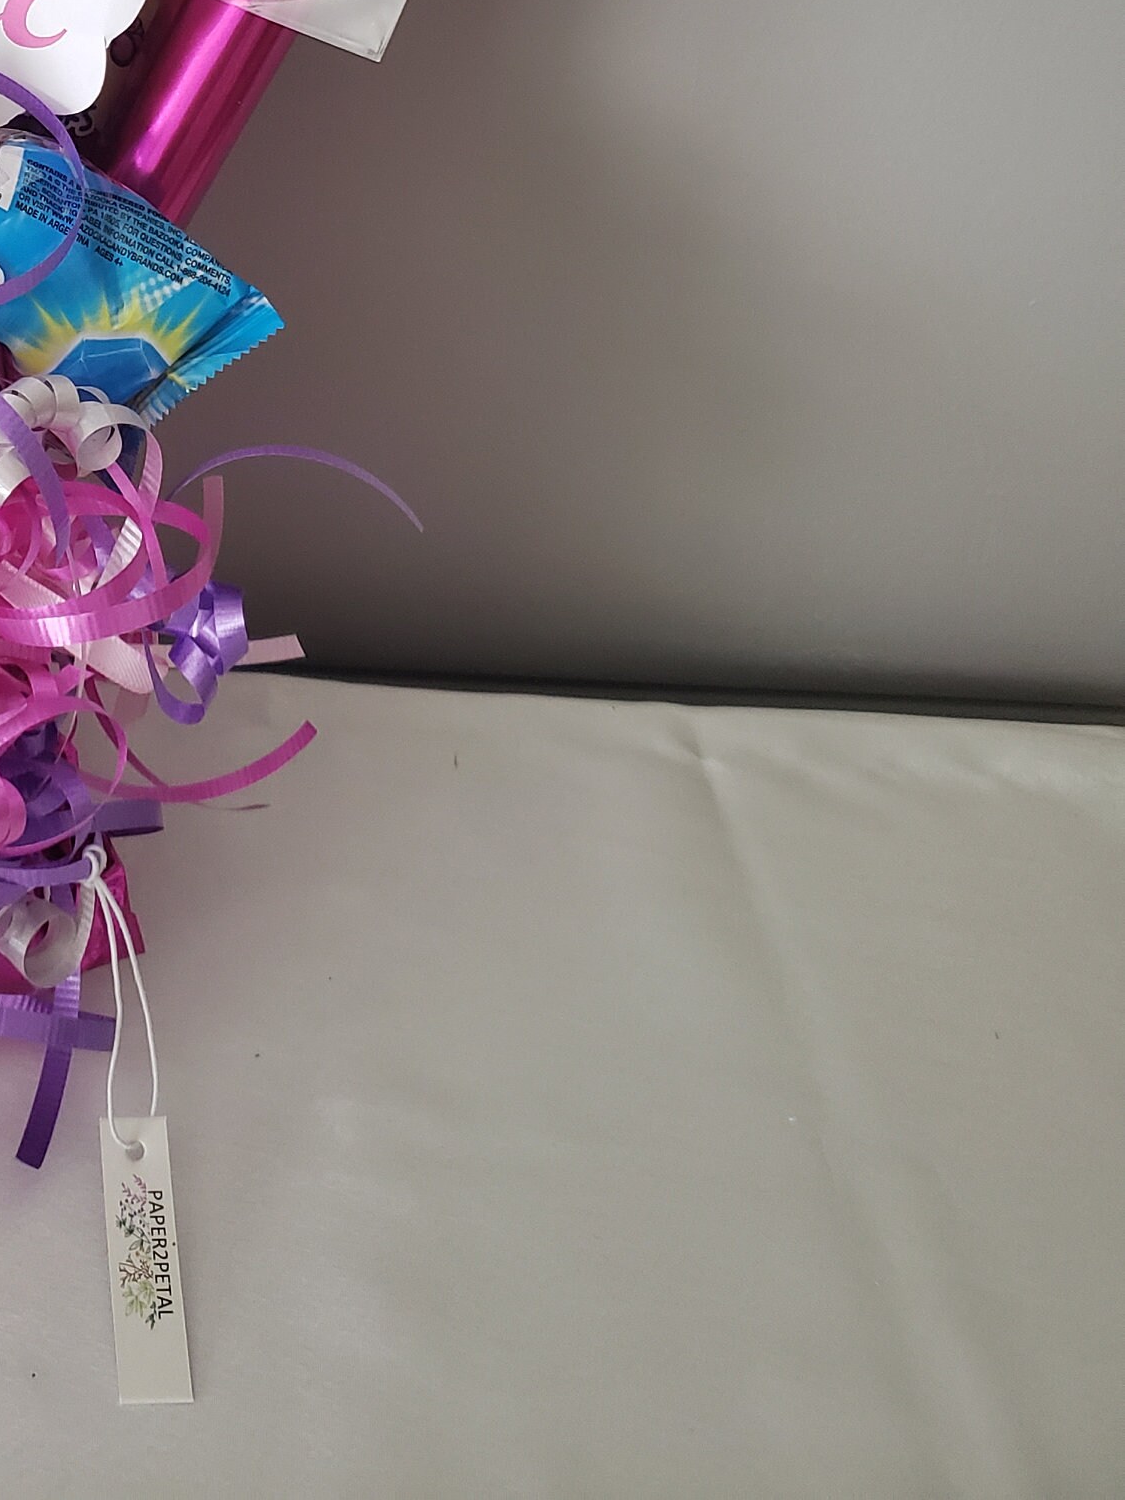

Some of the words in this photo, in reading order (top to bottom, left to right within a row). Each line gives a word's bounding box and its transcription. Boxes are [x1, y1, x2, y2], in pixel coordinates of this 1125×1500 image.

[15, 201, 40, 218] MADE
[39, 213, 49, 224] IN
[47, 219, 90, 248] ARGETINA
[94, 246, 115, 262] AGES
[115, 257, 124, 267] 4+
[18, 193, 31, 203] OR
[32, 199, 52, 213] VISIT
[20, 186, 38, 198] AND
[103, 225, 155, 258] INFORMATION
[156, 253, 175, 270] CALL
[133, 218, 147, 230] THE
[148, 226, 185, 251] BAZOOKA
[87, 206, 99, 216] PA
[122, 223, 139, 239] FOR
[185, 257, 231, 287] COMMENTS,
[148, 1190, 174, 1320] PAPER2PETAL
